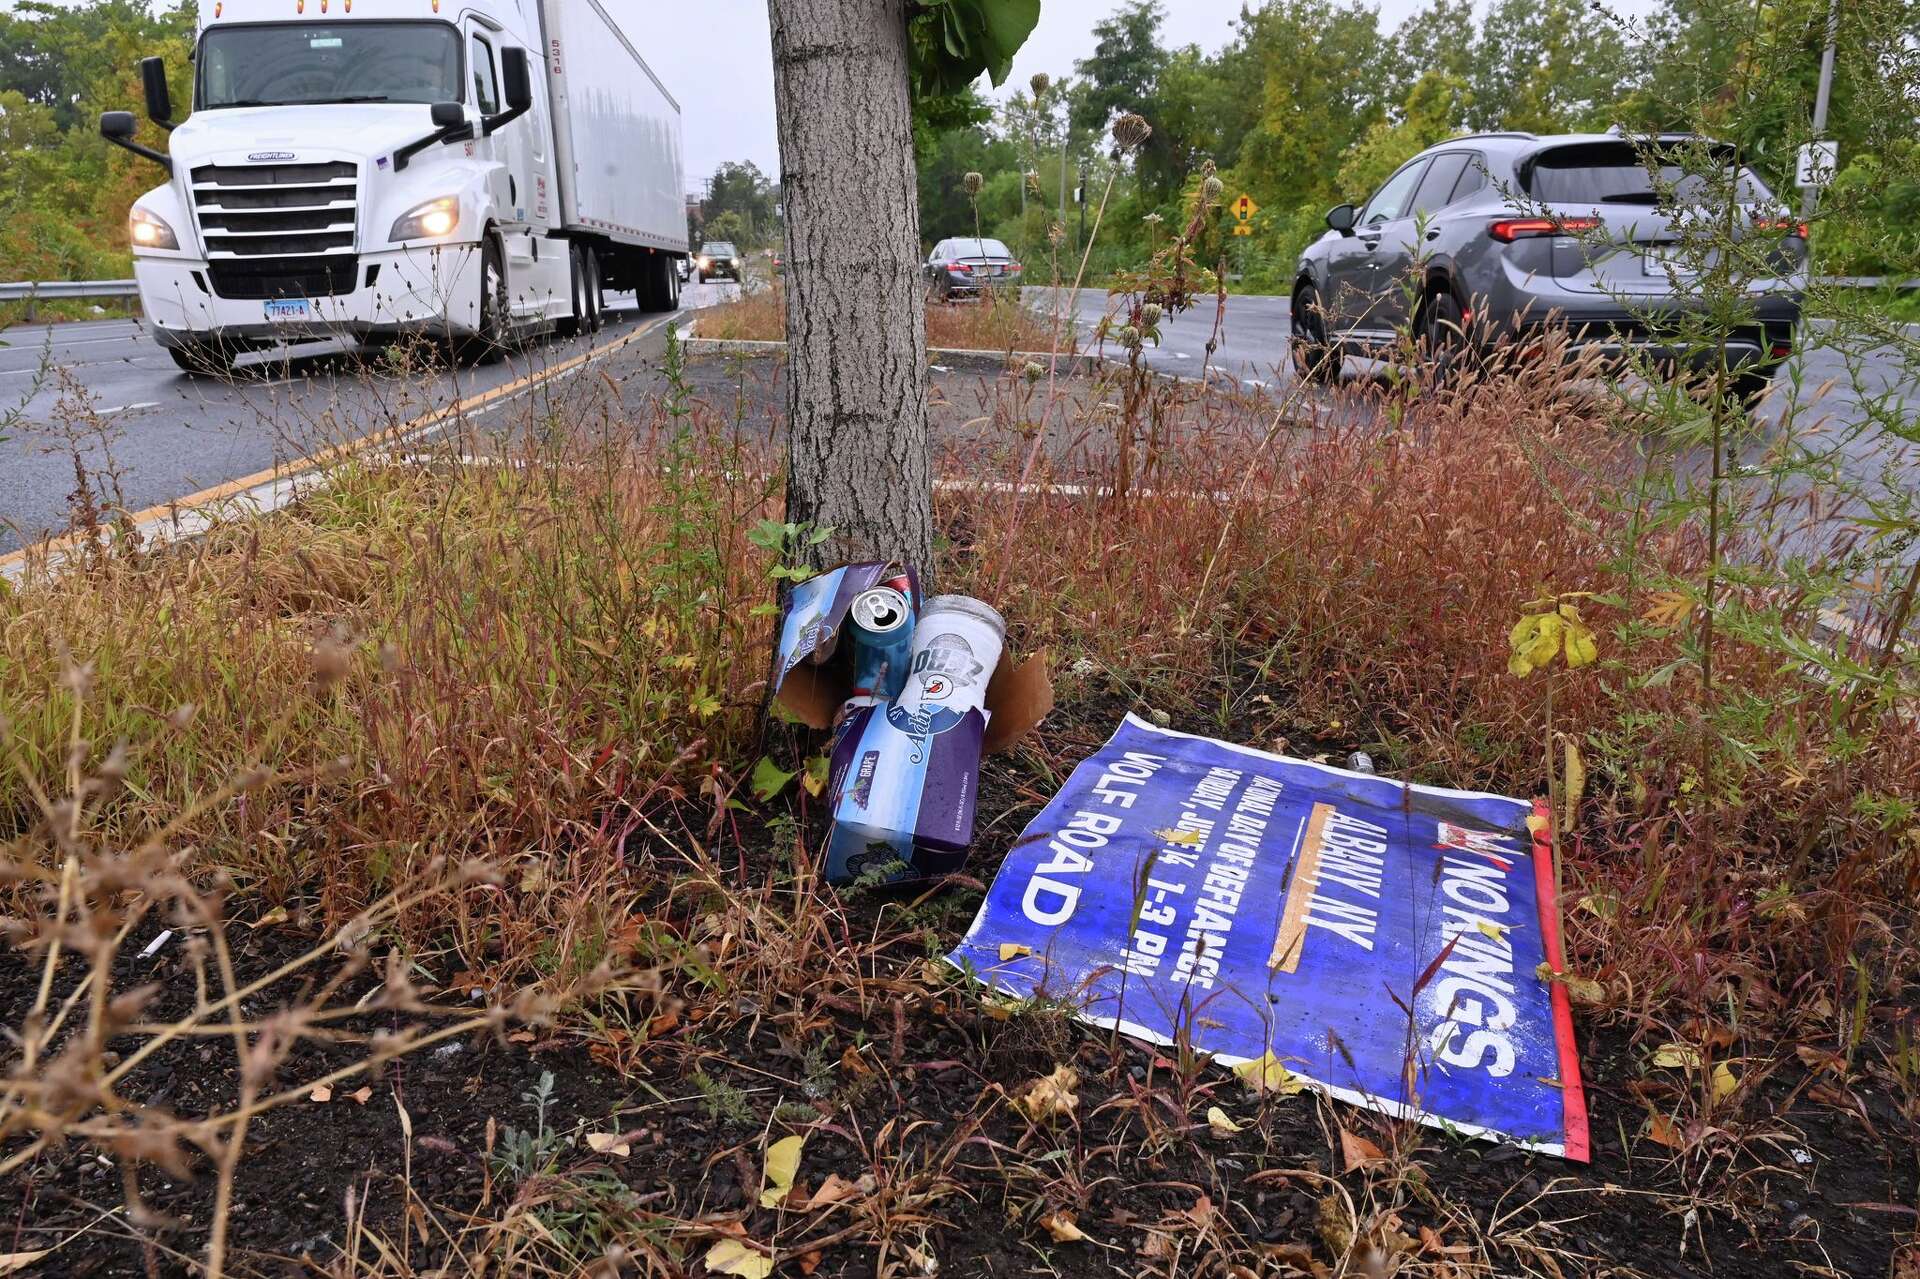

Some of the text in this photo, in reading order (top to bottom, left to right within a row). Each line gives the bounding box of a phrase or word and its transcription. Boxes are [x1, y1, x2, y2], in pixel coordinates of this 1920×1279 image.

[859, 753, 877, 778] GRAPE
[1022, 751, 1168, 927] WOLF ROAD
[1224, 813, 1268, 848] DAY
[1158, 849, 1200, 868] 14
[1216, 842, 1257, 869] OF
[1139, 878, 1187, 926] 1-3
[1299, 810, 1388, 951] ALBANY, NY
[1170, 863, 1249, 990] DEFIANCE
[1113, 929, 1168, 977] PM
[1431, 855, 1517, 1078] NO KINGS
